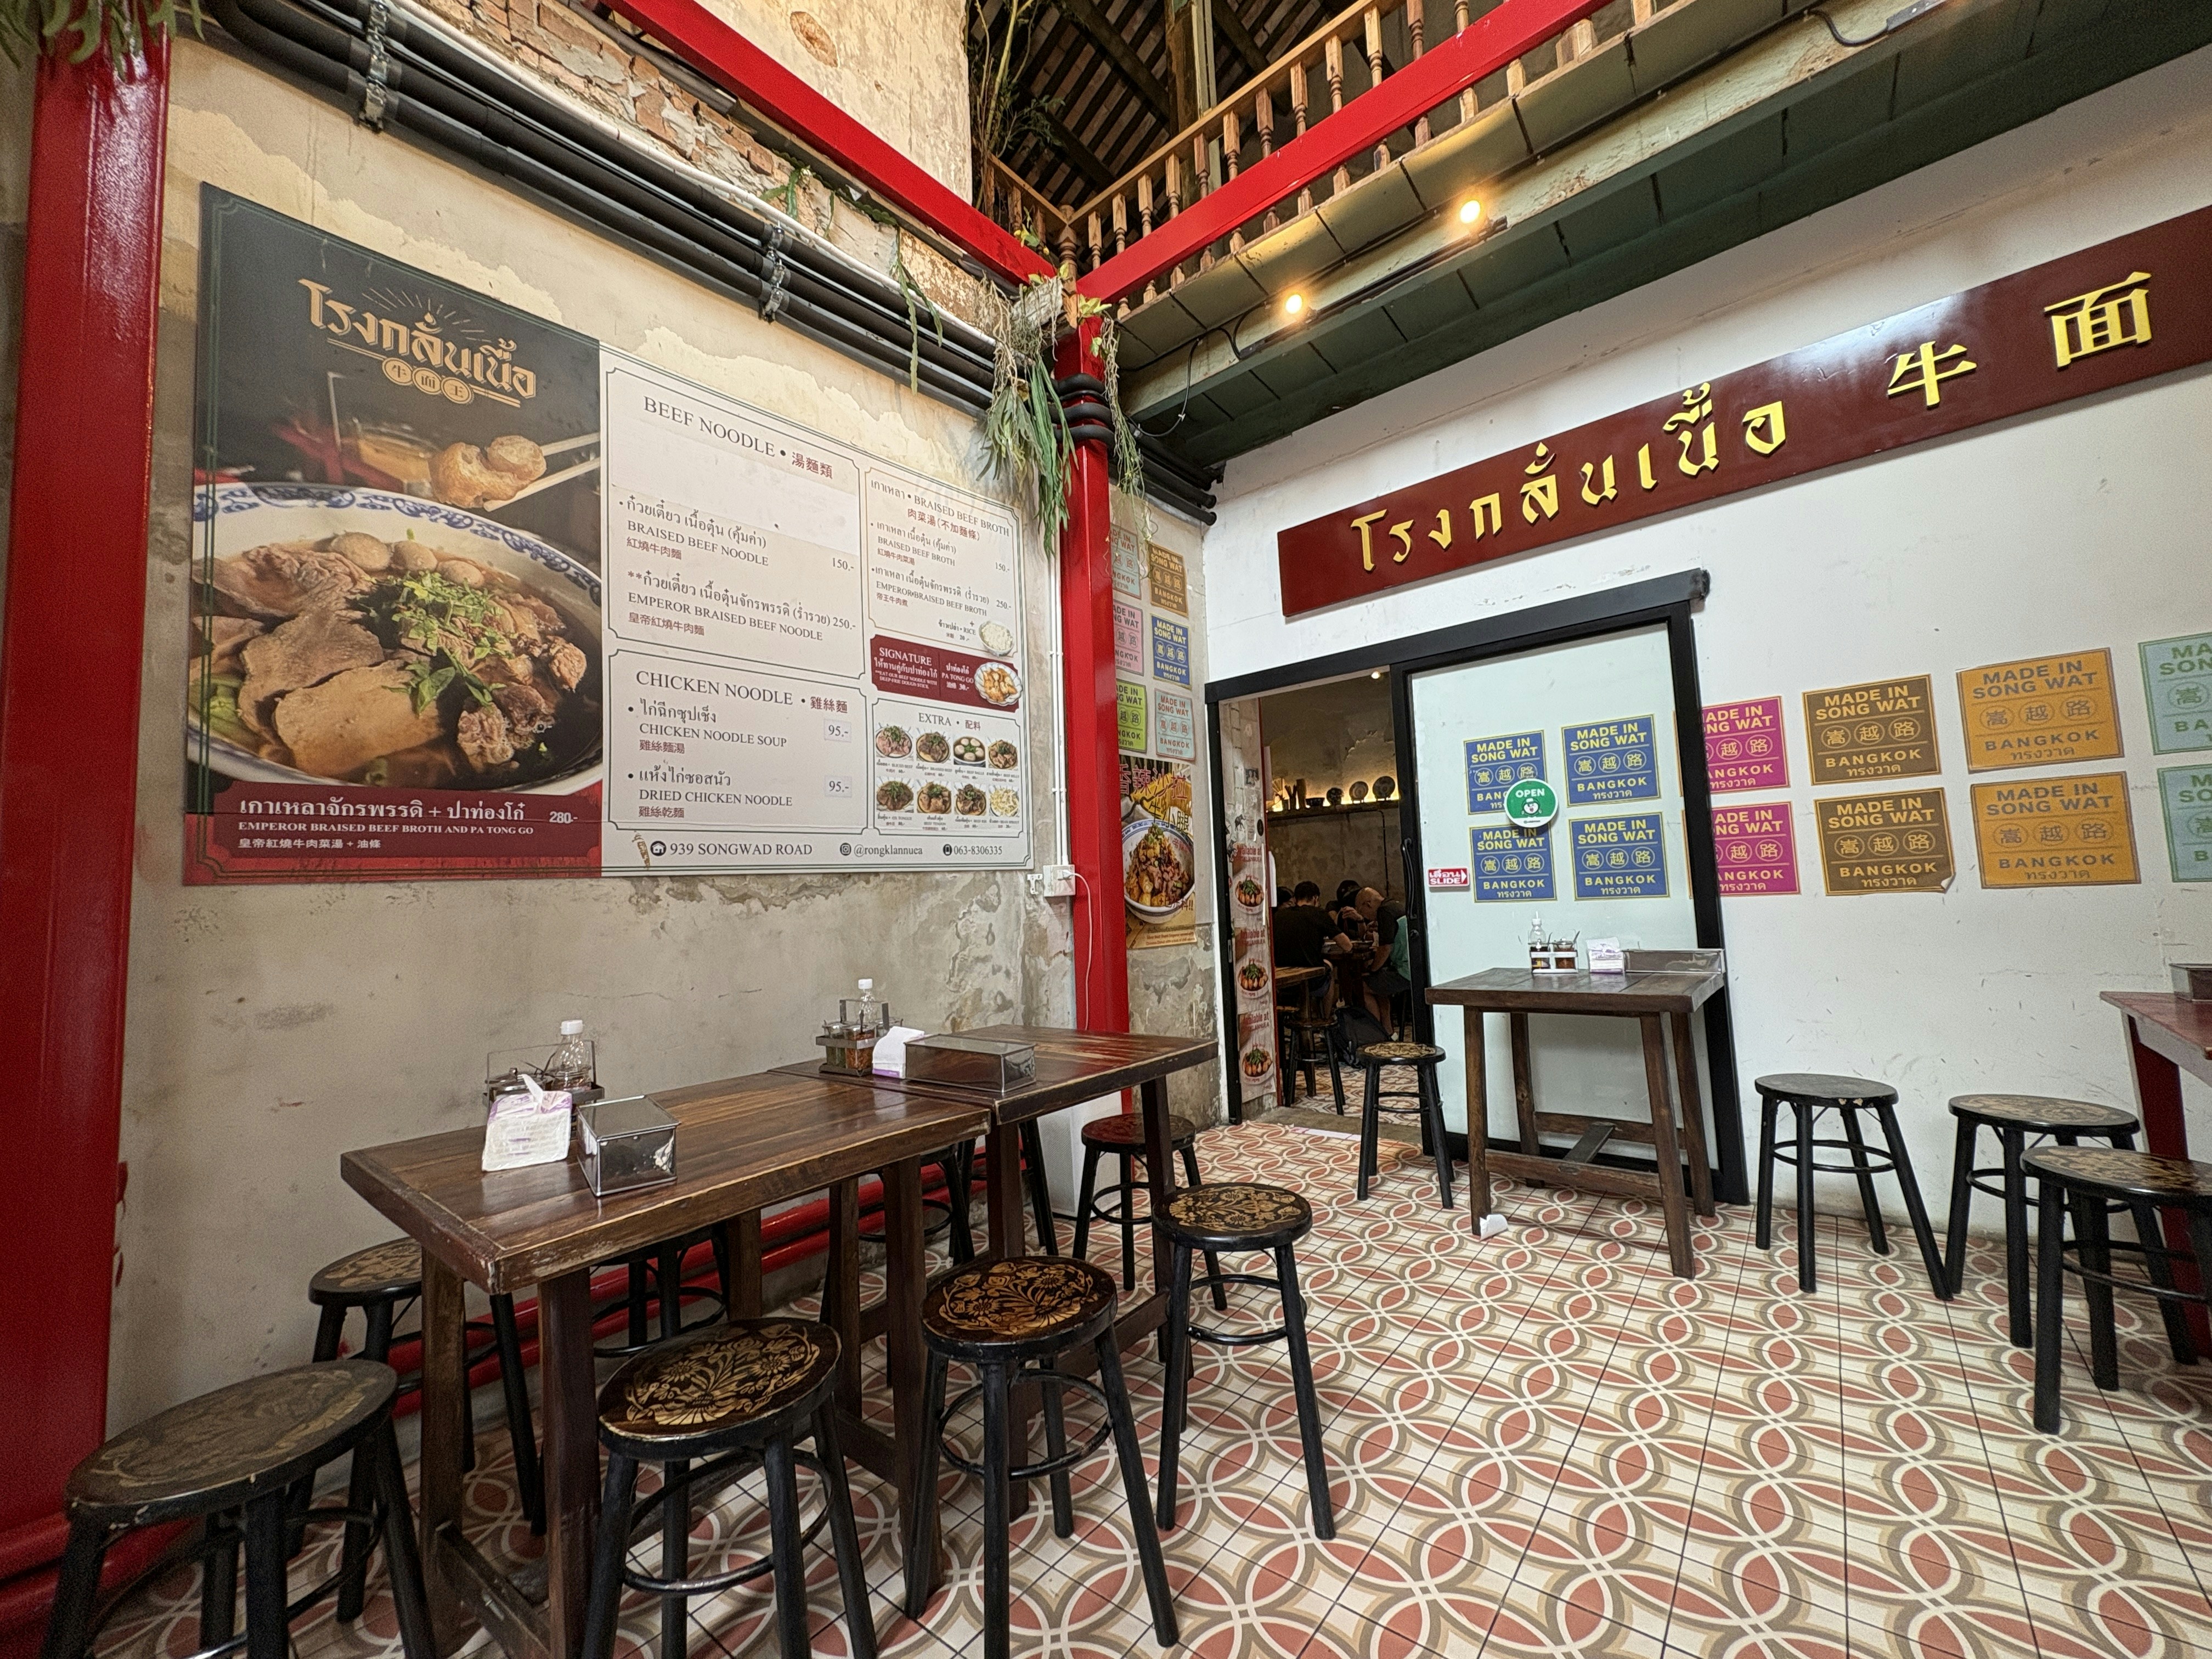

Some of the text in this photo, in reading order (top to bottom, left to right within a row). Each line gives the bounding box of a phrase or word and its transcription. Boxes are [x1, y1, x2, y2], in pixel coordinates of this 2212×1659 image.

[298, 279, 536, 399] โรงกลั่นเนื้อ
[644, 396, 694, 426] BEEF
[699, 416, 775, 456] NOODLE
[1350, 382, 1787, 573] โรงกลั่นเนื้อ
[915, 495, 955, 517] BRAISED
[957, 511, 978, 525] BEEF
[981, 520, 1009, 537] BROTH
[627, 521, 769, 566] BRAISED BEEF NOODLE
[878, 537, 955, 566] BRAISED BEEF BROTH
[947, 597, 962, 610] BEEF
[964, 604, 987, 616] BROTH
[628, 592, 823, 641] EMPEROR BRAISED BEEF NOODLE
[963, 627, 976, 635] RICE
[879, 647, 932, 666] SIGNATURE
[950, 674, 965, 682] TONG
[1983, 659, 2083, 685] MADE IN
[636, 671, 720, 695] CHICKEN
[725, 684, 793, 705] NOODLE
[1973, 672, 2098, 699] SONG WAT
[1824, 686, 1909, 707] MADE IN
[1816, 697, 1921, 720] SONG WAT
[1985, 699, 2091, 726] 嵩越路
[919, 712, 981, 731] EXTRA 配料
[639, 723, 787, 747] CHICKEN NOODLE SOUP
[1577, 723, 1638, 741] MADE IN
[1827, 721, 1915, 746] 嵩越路
[1985, 729, 2098, 751] BANGKOK
[1476, 737, 1531, 753] MADE IN
[1570, 732, 1647, 751] SONG WAT
[1471, 747, 1538, 763] SONG WAT
[1578, 752, 1641, 772] 嵩越路
[1826, 749, 1922, 768] BANGKOK
[2011, 747, 2075, 761] ทรงวาด
[1847, 764, 1901, 777] ทรงวาด
[1515, 788, 1545, 798] OPEN
[1577, 777, 1647, 792] BANGKOK
[1997, 783, 2098, 802] MADE IN
[639, 789, 793, 806] DRIED CHICKEN NOODLE
[1593, 789, 1632, 800] ทรงวาด
[239, 796, 424, 820] เกาเหลาจักรพรรดิ
[447, 800, 526, 821] ปาท่องโก๋
[1837, 797, 1922, 816] MADE IN
[1986, 796, 2113, 816] SONG WAT
[1584, 820, 1646, 833] MADE IN
[1829, 809, 1935, 828] SONG WAT
[238, 822, 307, 832] EMPEROR
[311, 822, 366, 832] BRAISED
[369, 823, 399, 832] BEEF
[402, 825, 442, 834] BROTH
[445, 826, 467, 834] AND
[487, 826, 515, 835] TONG
[518, 827, 534, 835] GO
[1482, 828, 1537, 840] MADE IN
[1578, 830, 1655, 844] SONG WAT
[2000, 822, 2108, 844] 嵩越路
[670, 843, 812, 855] 939 SONGWAD ROAD
[854, 844, 923, 857] @rongklannuea
[953, 845, 1002, 855] 063-8306335
[1477, 838, 1544, 850] SONG WAT
[1839, 834, 1930, 857] 嵩越路
[1484, 854, 1541, 872] 嵩越路
[1586, 848, 1651, 866] 嵩越路
[1999, 854, 2115, 868] BANGKOK
[1839, 862, 1937, 877] BANGKOK
[2024, 869, 2090, 881] ทรงวาด
[1483, 879, 1545, 889] BANGKOK
[1585, 874, 1656, 886] BANGKOK
[1720, 883, 1766, 891] ทรงวาด
[1862, 877, 1917, 888] ทรงวาด
[1497, 888, 1532, 898] ทรงวาด
[1601, 885, 1641, 895] ทรงวาด
